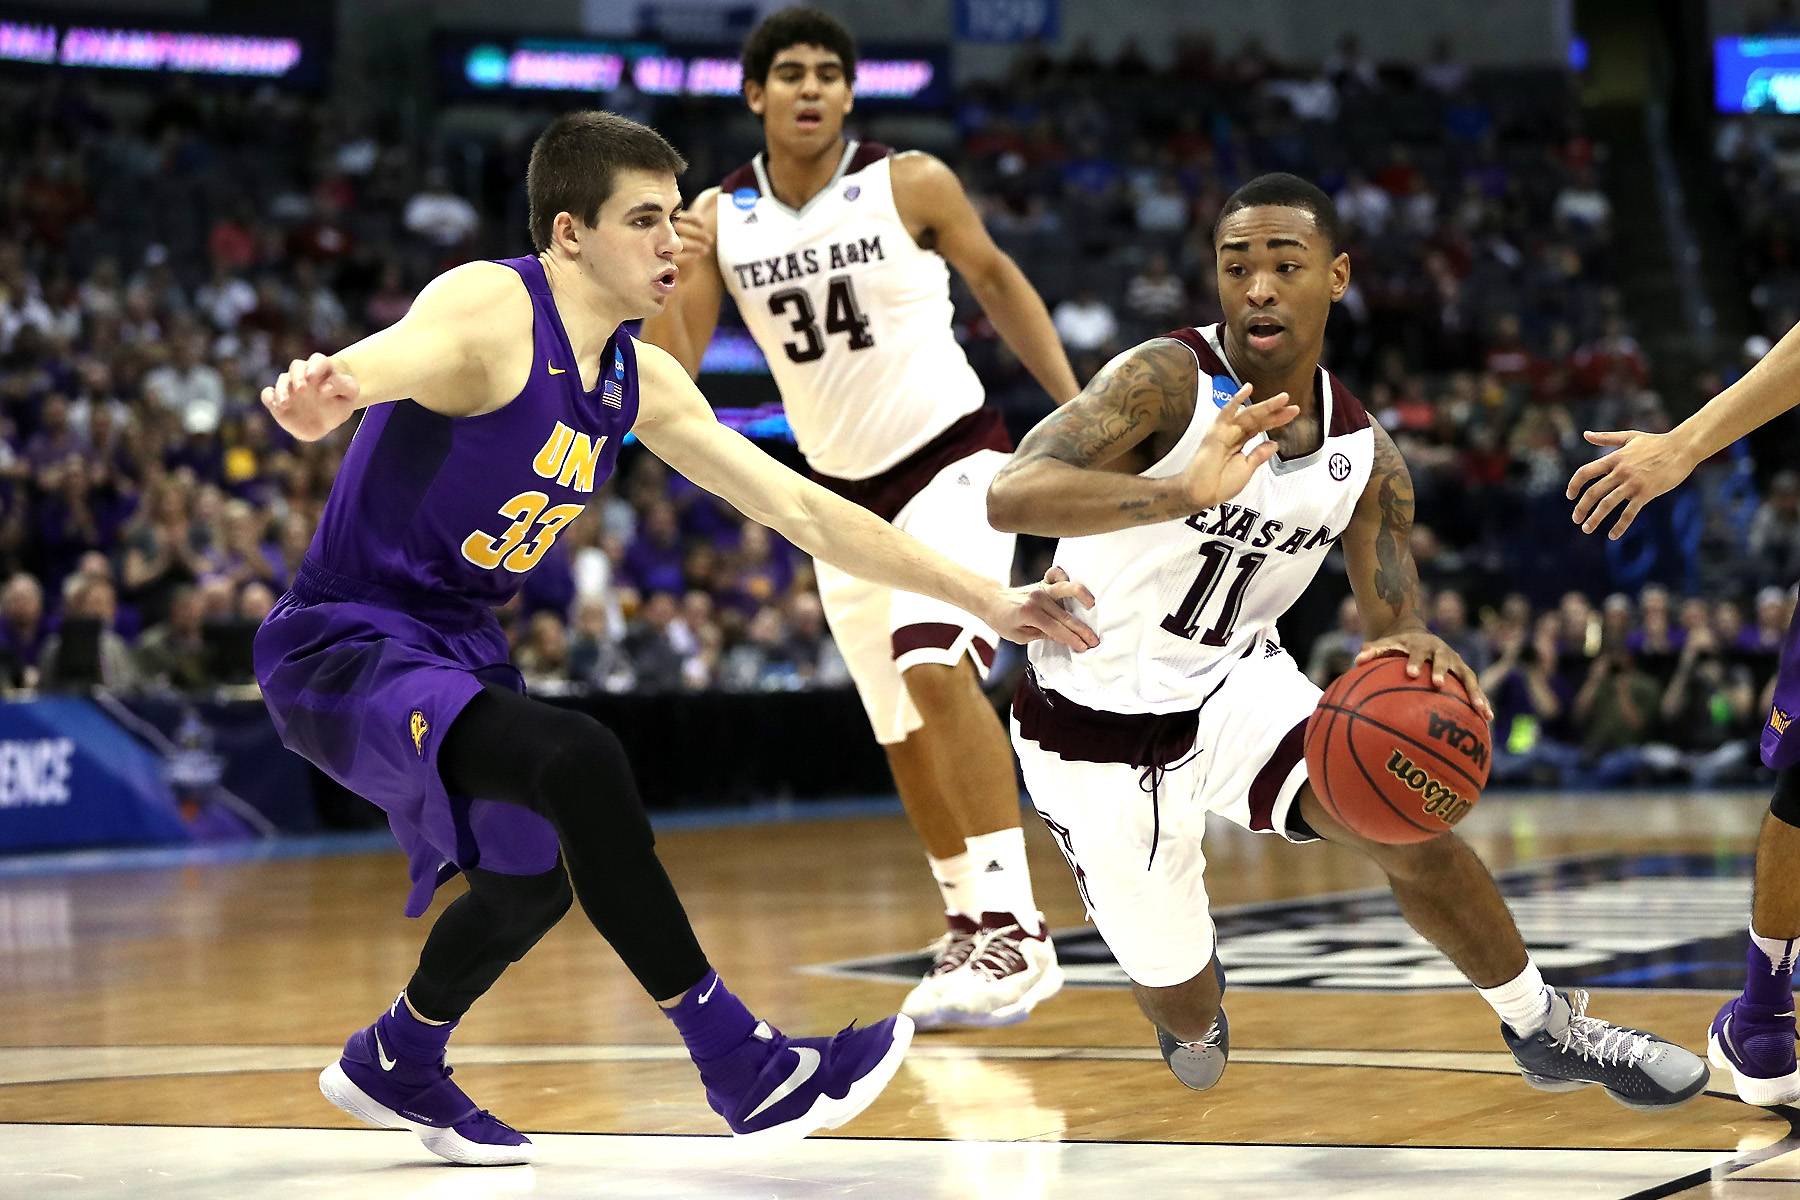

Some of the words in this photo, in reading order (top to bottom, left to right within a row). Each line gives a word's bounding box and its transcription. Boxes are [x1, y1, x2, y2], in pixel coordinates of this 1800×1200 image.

[733, 249, 819, 289] TEXAS
[829, 234, 885, 270] A&M
[767, 273, 876, 364] 34
[1330, 454, 1351, 480] SEC
[460, 491, 586, 574] 33
[1184, 502, 1284, 548] EXAS
[1159, 540, 1268, 647] 11
[1428, 709, 1488, 772] NCAA
[1385, 748, 1473, 826] Wilson
